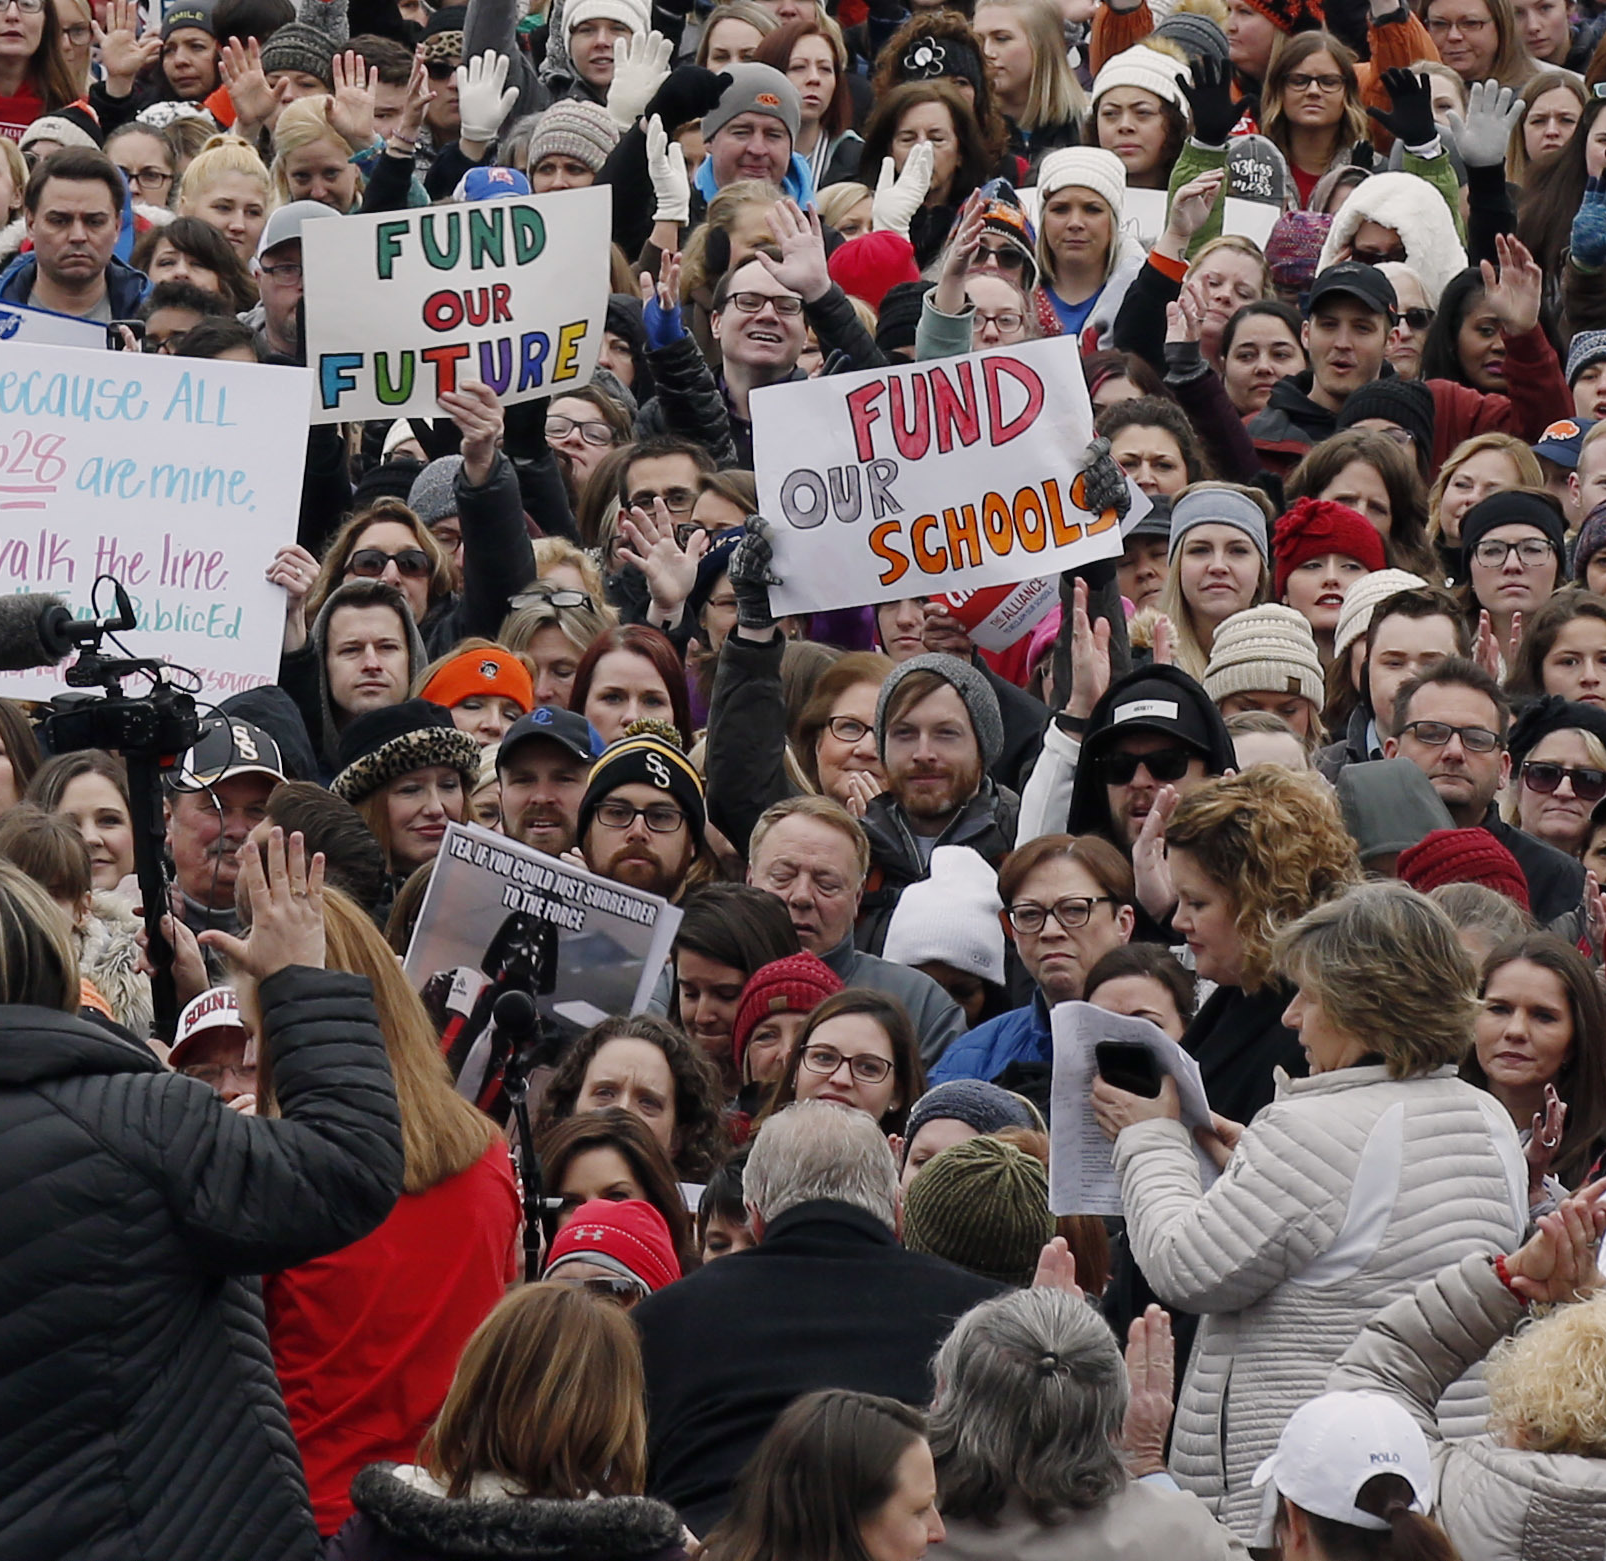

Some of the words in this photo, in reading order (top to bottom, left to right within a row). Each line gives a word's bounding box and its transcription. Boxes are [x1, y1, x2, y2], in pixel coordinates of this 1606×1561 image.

[375, 204, 547, 280] FUND
[422, 282, 513, 333] OUR
[318, 319, 590, 409] FUTURE
[161, 370, 238, 427] ALL
[846, 355, 1045, 463] FUND
[74, 453, 147, 501] are
[149, 463, 258, 512] mine.
[780, 457, 905, 530] OUR
[94, 535, 151, 589] the
[161, 532, 229, 590] line.
[868, 470, 1118, 586] SCHOOLS
[474, 843, 490, 869] IF
[487, 848, 514, 877] YOU
[512, 858, 554, 891] COULD
[553, 874, 586, 903] JUST
[583, 884, 658, 927] SURRENDER
[502, 884, 523, 909] TO
[521, 892, 545, 919] THE
[543, 899, 586, 932] FORCE
[1368, 1452, 1402, 1464] POLO
